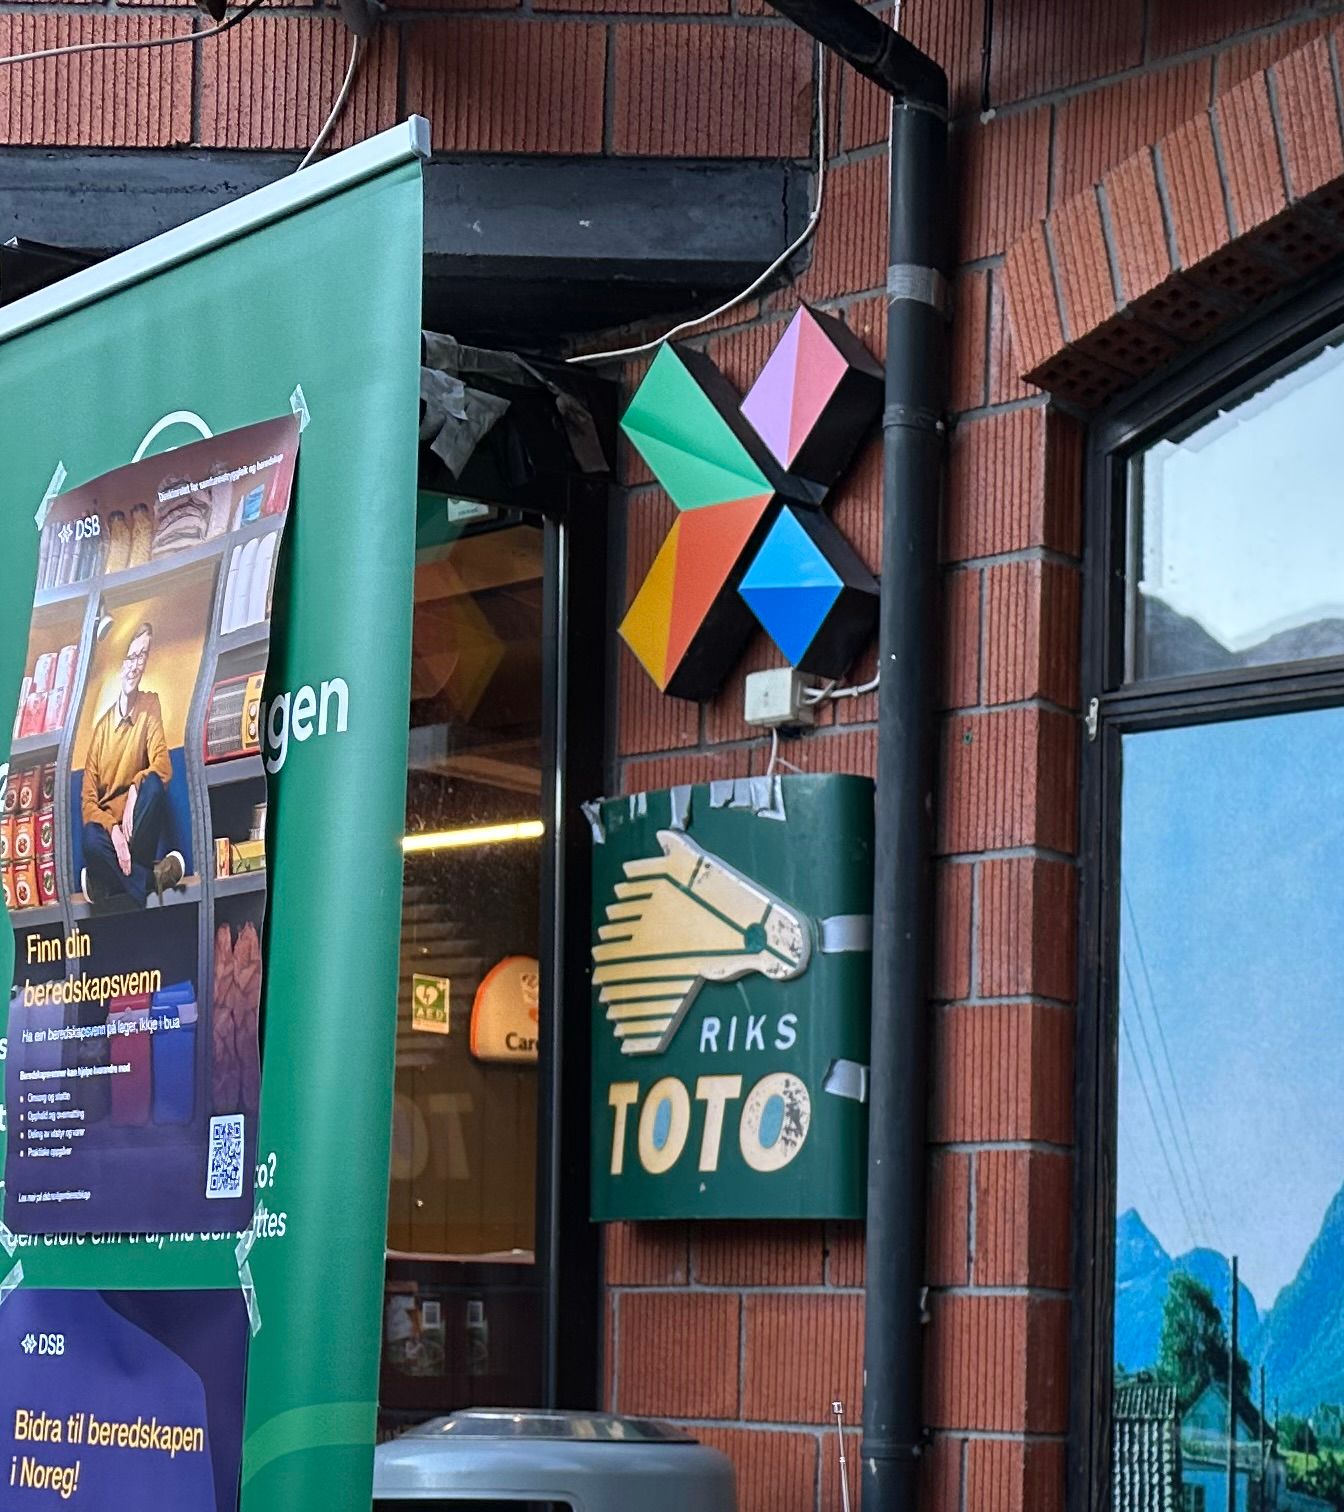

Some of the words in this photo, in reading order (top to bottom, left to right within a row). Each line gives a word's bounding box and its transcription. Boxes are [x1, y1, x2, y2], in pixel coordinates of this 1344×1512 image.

[75, 514, 101, 542] DSB
[264, 676, 348, 774] gen
[27, 933, 61, 964] Finn
[66, 929, 91, 958] din
[24, 969, 161, 1008] beredskapsvenn
[22, 1029, 33, 1043] Ha
[34, 1028, 46, 1043] ein
[48, 1022, 106, 1043] beredskapsvenn
[107, 1022, 116, 1038] på
[164, 1015, 181, 1030] bua
[415, 1007, 444, 1020] AED
[505, 1031, 539, 1051] Car
[700, 1012, 798, 1054] RIKS
[608, 1071, 811, 1176] TOTO
[38, 1333, 65, 1356] DSB
[15, 1409, 62, 1444] Bidra
[67, 1412, 85, 1445] til
[87, 1413, 204, 1458] beredskapen
[10, 1456, 17, 1486] i
[19, 1456, 80, 1499] Noreg!
